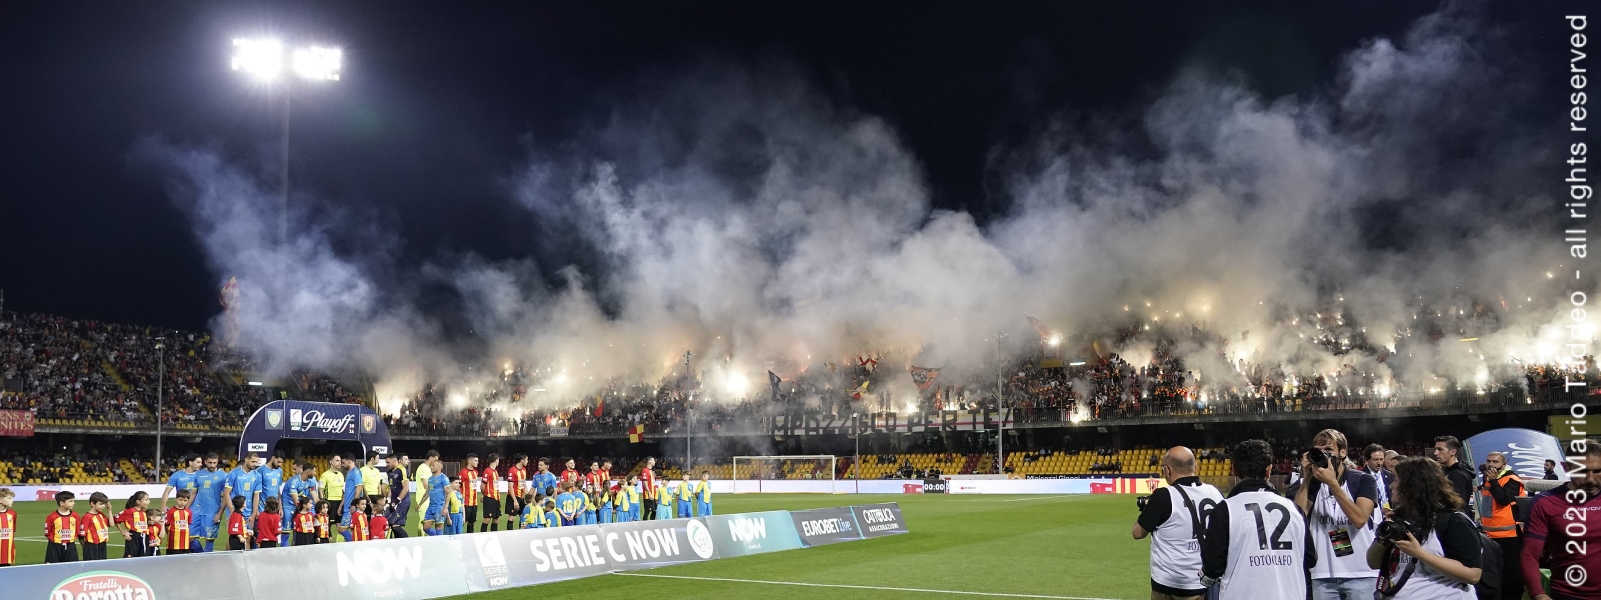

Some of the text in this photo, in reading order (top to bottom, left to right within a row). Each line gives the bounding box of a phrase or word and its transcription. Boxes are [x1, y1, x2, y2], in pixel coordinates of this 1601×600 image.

[302, 410, 355, 433] Playoff
[907, 410, 957, 433] PER
[563, 499, 573, 513] 16
[863, 508, 896, 523] CATTOLICA
[728, 517, 766, 542] NOW
[1244, 502, 1293, 550] 12
[529, 527, 680, 573] SERIE C NOW
[336, 545, 423, 587] NOW
[484, 565, 508, 575] SERIE C
[79, 579, 118, 591] Fratelli
[490, 576, 508, 587] NOW
